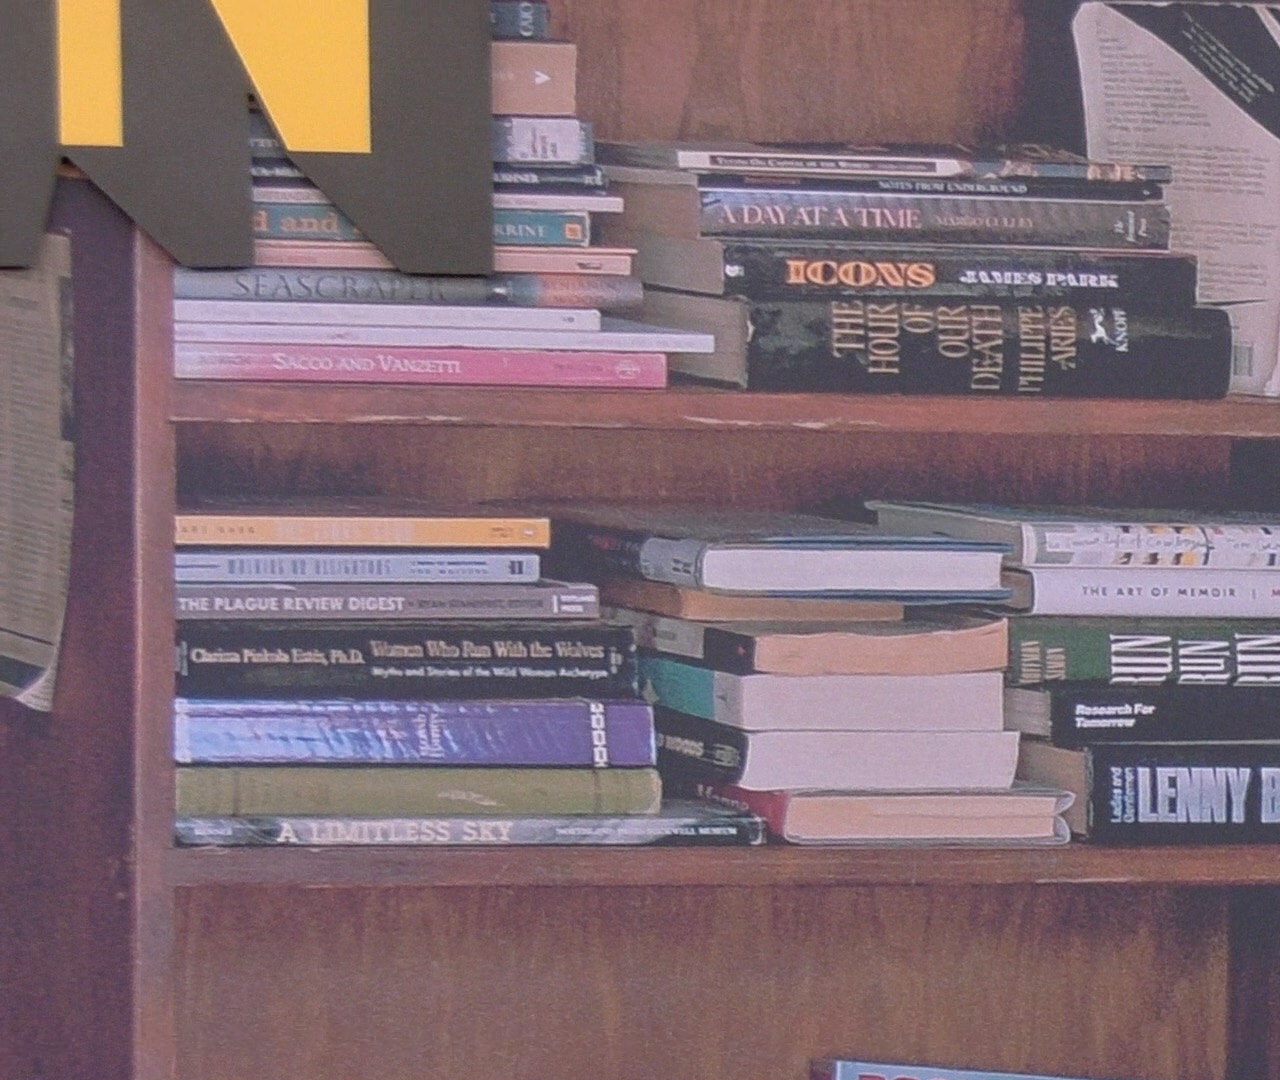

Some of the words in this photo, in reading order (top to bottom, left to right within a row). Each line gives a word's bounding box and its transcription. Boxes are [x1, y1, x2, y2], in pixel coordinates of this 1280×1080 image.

[280, 211, 338, 234] and
[742, 206, 789, 226] DAY
[856, 208, 922, 228] TIME
[785, 259, 936, 289] ICONS
[959, 271, 1041, 287] JAMES
[1046, 273, 1119, 289] PARK
[832, 301, 865, 358] THE
[902, 304, 935, 334] OF
[937, 304, 969, 359] OUR
[1112, 308, 1128, 353] KNOPF
[868, 302, 899, 375] HOUR
[971, 304, 1001, 392] DEATH
[1017, 304, 1048, 394] PHILIPPE
[1050, 305, 1078, 370] ARIES
[273, 352, 333, 370] SACCO
[337, 356, 376, 371] AND
[378, 353, 462, 374] VANZETTI
[179, 598, 212, 611] THE
[213, 597, 280, 612] PLAGUE
[283, 597, 346, 611] REVIEW
[348, 597, 406, 611] DIGEST
[1081, 585, 1109, 597] THE
[1116, 586, 1144, 598] ART
[1150, 586, 1170, 598] OF
[1177, 587, 1237, 599] MEMOIR
[331, 649, 365, 664] Ph.D.
[370, 641, 424, 658] Women
[427, 641, 461, 659] Who
[463, 641, 492, 658] Run
[494, 641, 527, 659] With
[529, 641, 554, 659] the
[556, 641, 605, 660] Wolves
[1109, 634, 1172, 685] RUN
[1177, 640, 1231, 686] RUN
[1075, 704, 1134, 717] Research
[1136, 704, 1156, 716] For
[1075, 717, 1136, 729] Tomorrow
[1137, 766, 1251, 825] LENNY
[277, 821, 297, 843] A
[311, 822, 452, 842] LIMITLESS
[462, 822, 515, 842] SKY
